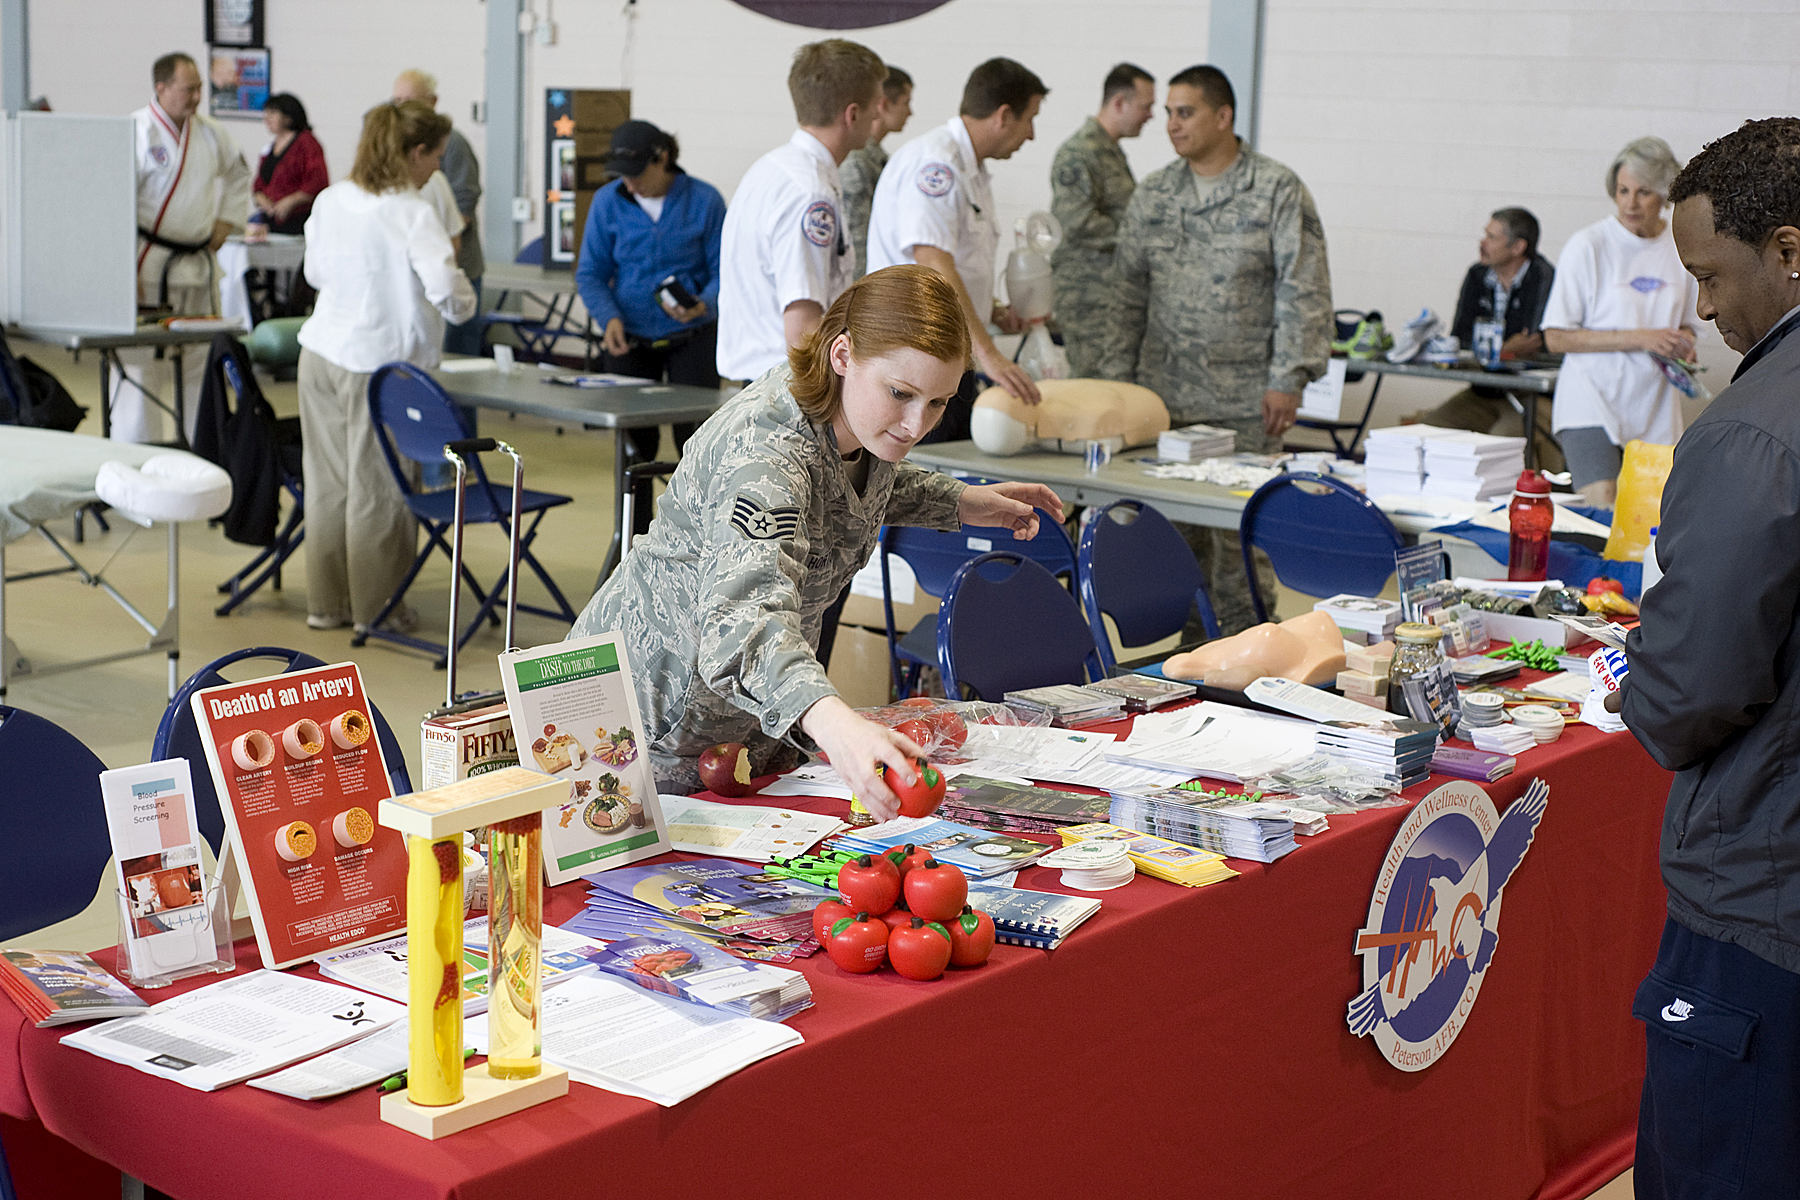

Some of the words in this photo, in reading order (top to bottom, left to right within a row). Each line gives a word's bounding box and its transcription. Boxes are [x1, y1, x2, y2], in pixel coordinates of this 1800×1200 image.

[562, 662, 571, 674] TO
[571, 659, 583, 672] THE
[583, 656, 596, 671] DIET
[210, 693, 259, 720] Death
[260, 688, 276, 710] of
[279, 686, 299, 707] an
[301, 676, 354, 702] Artery
[425, 728, 456, 743] FIFTY50
[462, 727, 518, 764] FIFTY
[333, 751, 355, 760] REDUCED
[284, 762, 304, 771] BUILDUP
[305, 758, 324, 767] BEGINS
[470, 764, 487, 778] 100%
[487, 762, 510, 774] WHOLE
[236, 773, 253, 782] CLEAR
[253, 770, 272, 779] ARTERY
[138, 790, 158, 800] Blood
[133, 801, 166, 812] Pressure
[133, 812, 170, 824] Screening
[911, 826, 950, 842] DASH
[334, 852, 354, 861] DAMAGE
[354, 848, 374, 857] OCCURS
[1375, 844, 1404, 906] Health
[1403, 811, 1423, 844] and
[1424, 790, 1468, 818] Wellness
[1469, 794, 1493, 836] Center
[287, 866, 300, 874] HIGH
[329, 932, 350, 943] HEALTH
[368, 940, 408, 953] Founda
[627, 942, 681, 958] Weight
[1670, 997, 1694, 1018] NIKE
[1391, 1040, 1431, 1066] Peterson
[1459, 986, 1475, 1018] CO
